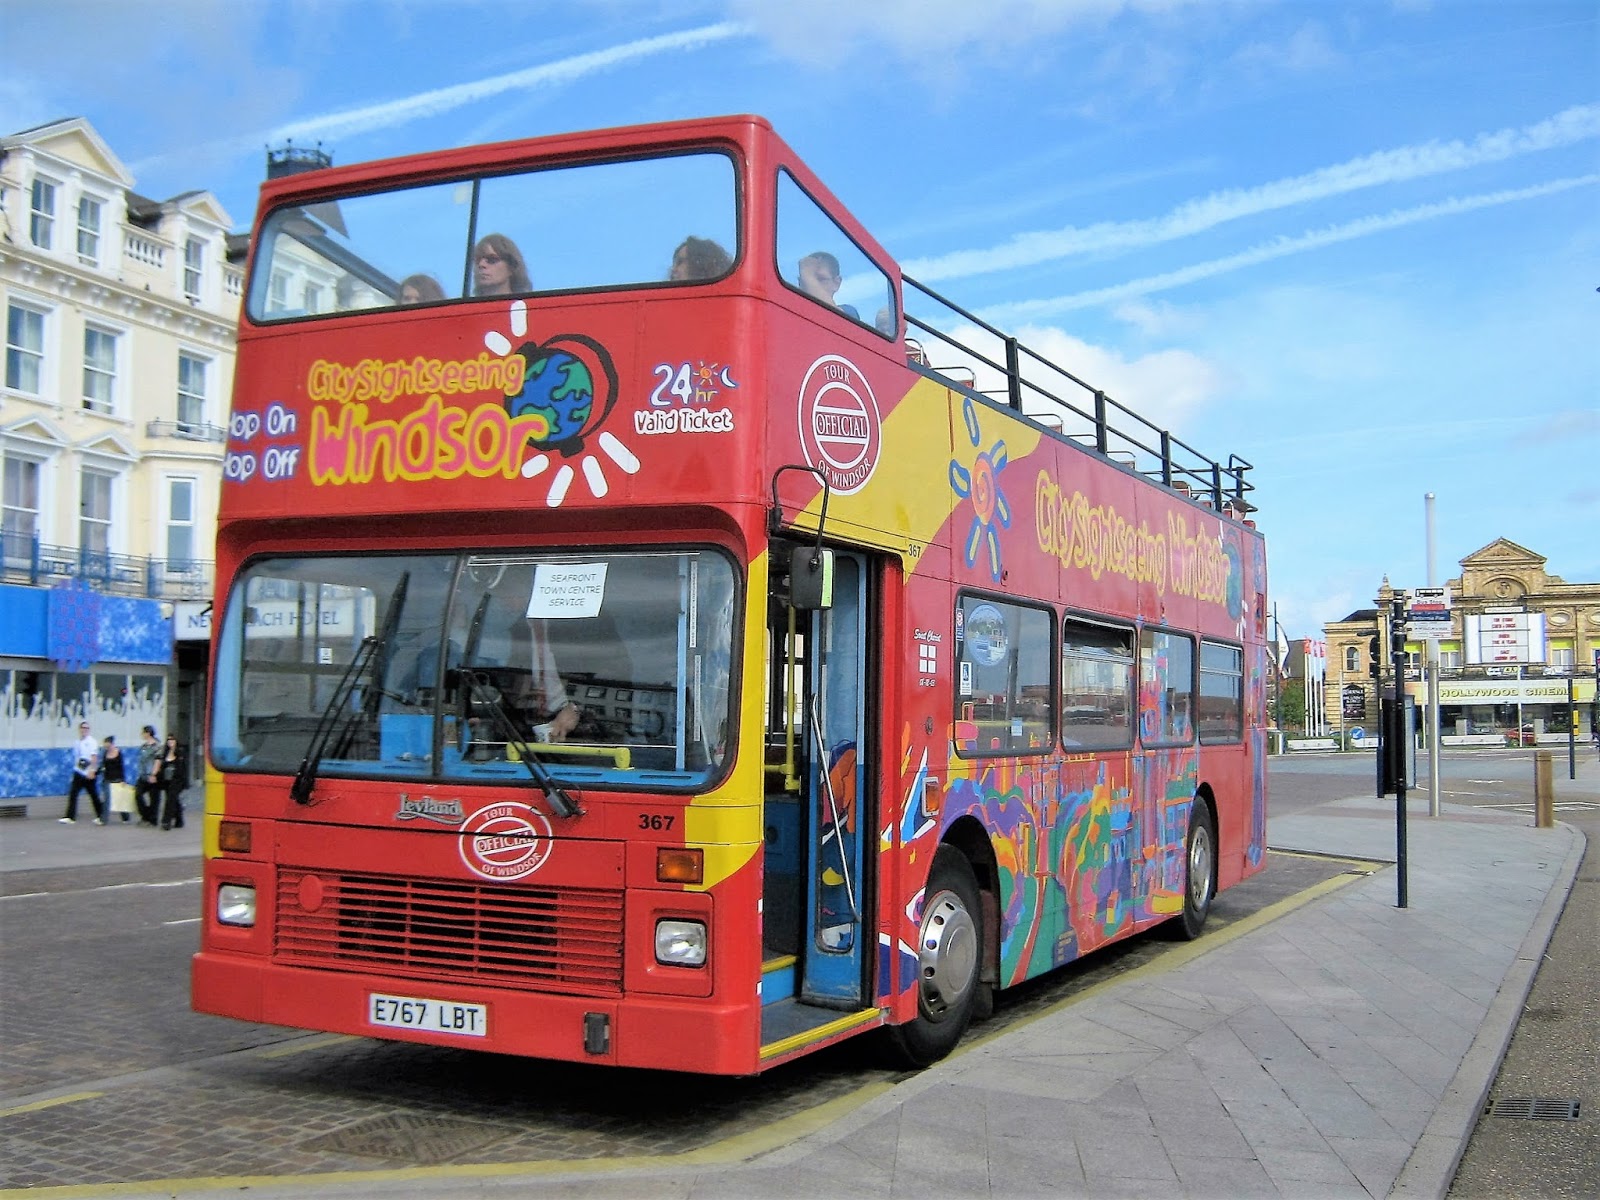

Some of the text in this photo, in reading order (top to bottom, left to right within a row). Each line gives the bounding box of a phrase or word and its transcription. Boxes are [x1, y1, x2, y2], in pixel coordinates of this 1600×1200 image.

[650, 363, 718, 406] 24 hr
[824, 364, 851, 384] TOUR
[266, 404, 297, 435] On
[635, 410, 733, 433] Valid Ticket
[816, 413, 867, 438] OFFICIAL
[307, 394, 549, 486] Windsor
[263, 448, 300, 479] Off
[818, 457, 871, 487] OF WINDSOR
[908, 543, 921, 558] 367
[551, 573, 597, 583] SEAFRONT
[539, 585, 601, 595] TOWN CENTRE
[548, 598, 586, 607] SERVICE
[289, 610, 340, 626] HOEL
[1440, 686, 1569, 698] HOLLYWOOD CINEM
[483, 807, 513, 821] TOUR
[638, 814, 676, 831] 367
[477, 831, 535, 852] OFFICIAL
[481, 852, 542, 876] OF WINDSOR
[375, 999, 479, 1031] E767 LBT
